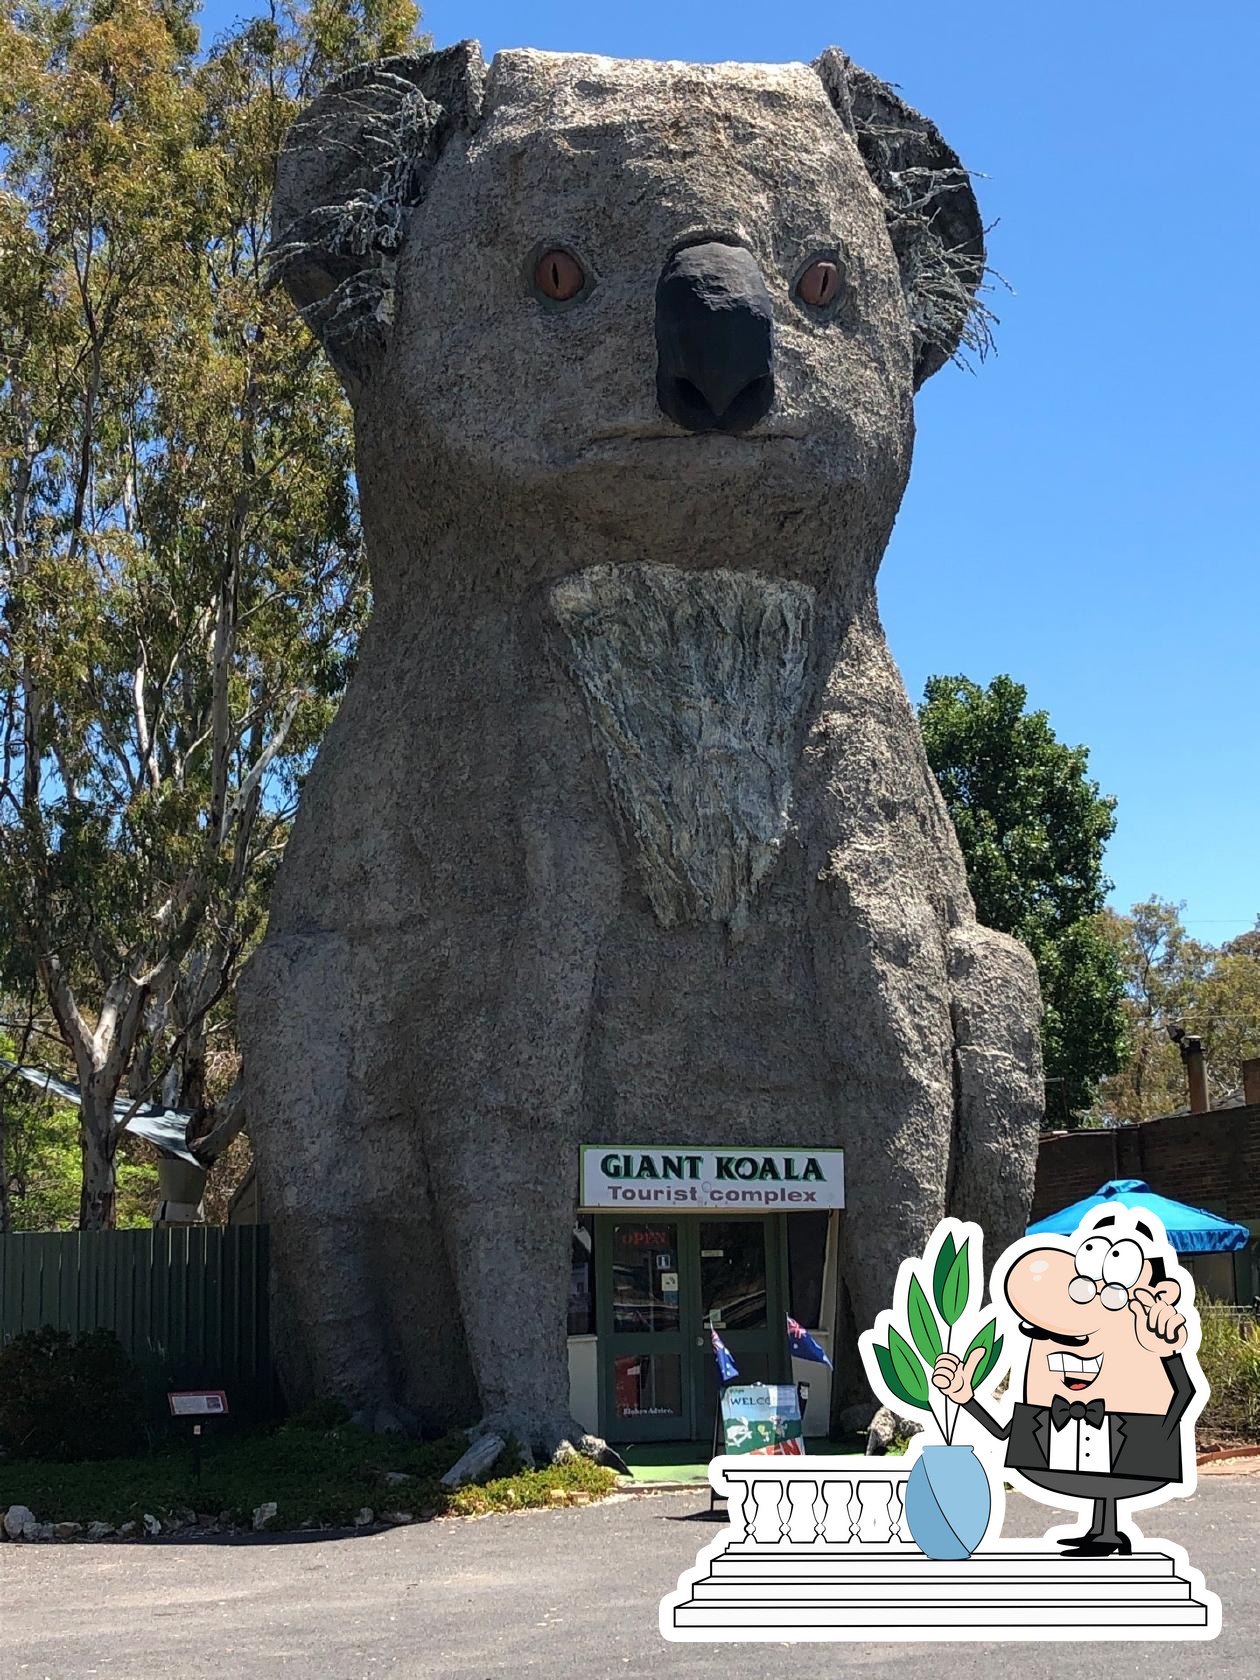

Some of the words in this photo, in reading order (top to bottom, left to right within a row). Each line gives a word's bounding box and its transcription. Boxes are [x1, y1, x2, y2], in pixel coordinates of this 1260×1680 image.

[600, 1153, 704, 1181] GIANT
[715, 1155, 827, 1182] KOALA
[607, 1185, 698, 1201] Tourist
[709, 1187, 817, 1205] complex
[621, 1231, 667, 1246] OPEN
